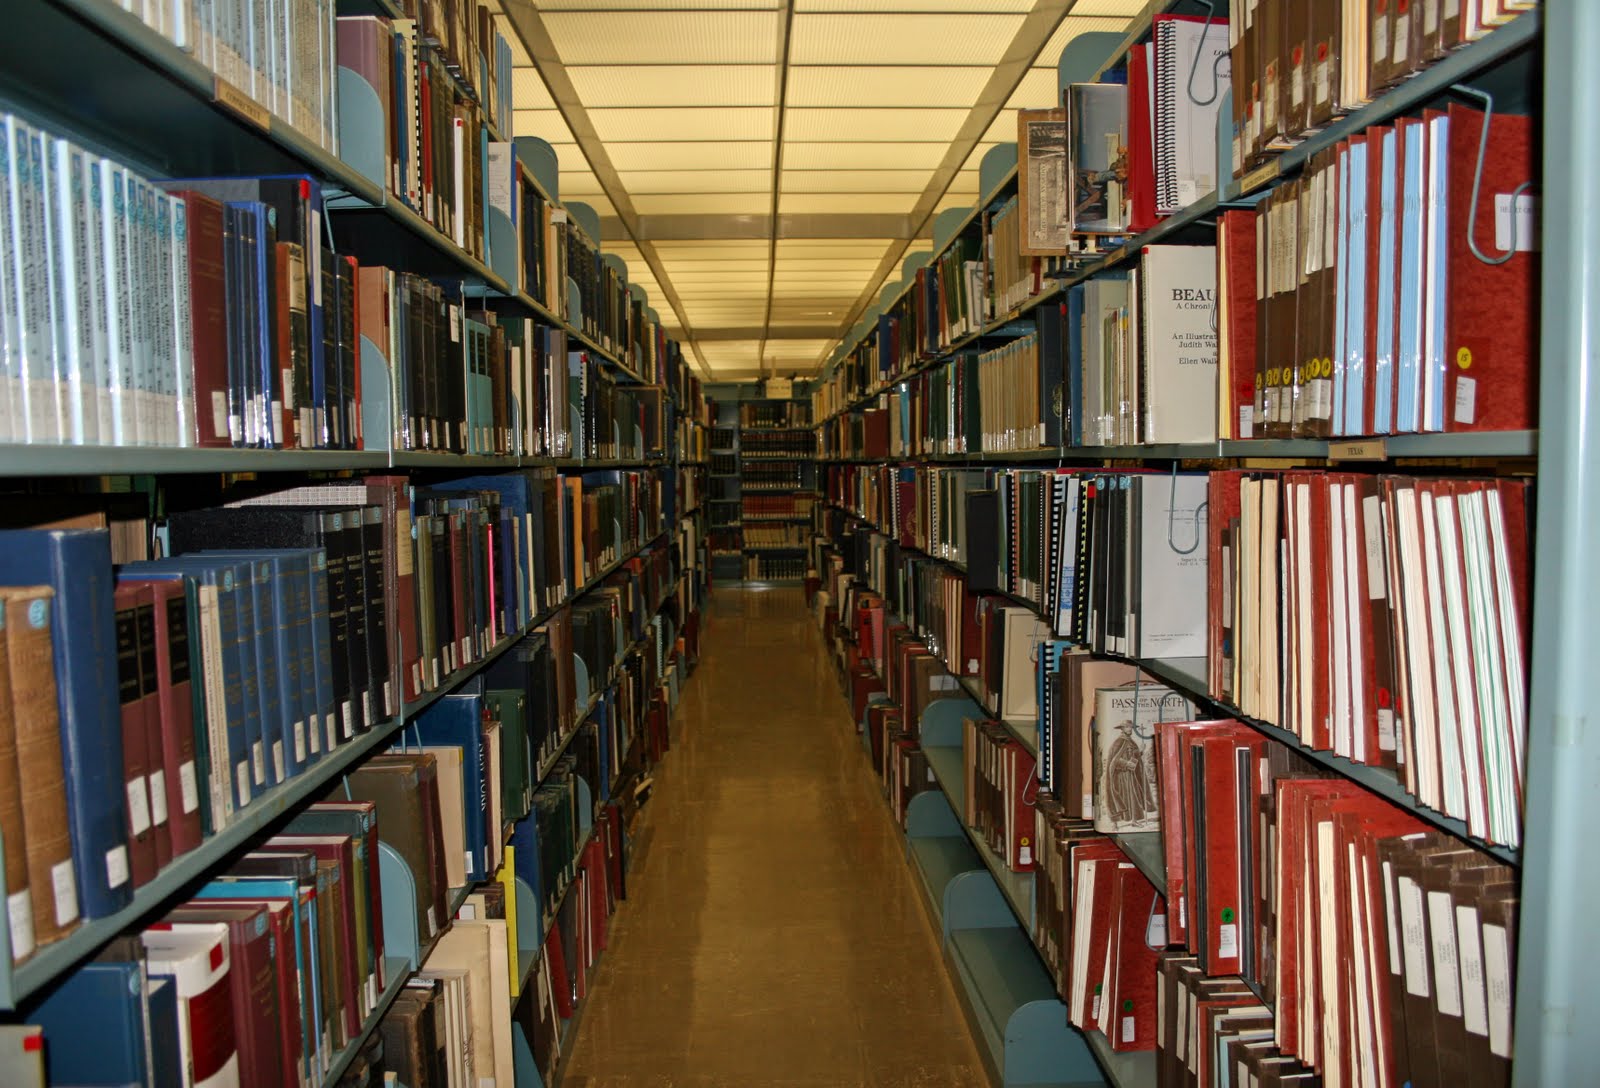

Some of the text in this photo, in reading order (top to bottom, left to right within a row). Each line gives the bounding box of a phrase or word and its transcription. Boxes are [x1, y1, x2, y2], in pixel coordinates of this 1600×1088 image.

[1347, 447, 1364, 456] TEXAS
[1112, 698, 1136, 708] PASS
[1150, 697, 1185, 708] NORTH
